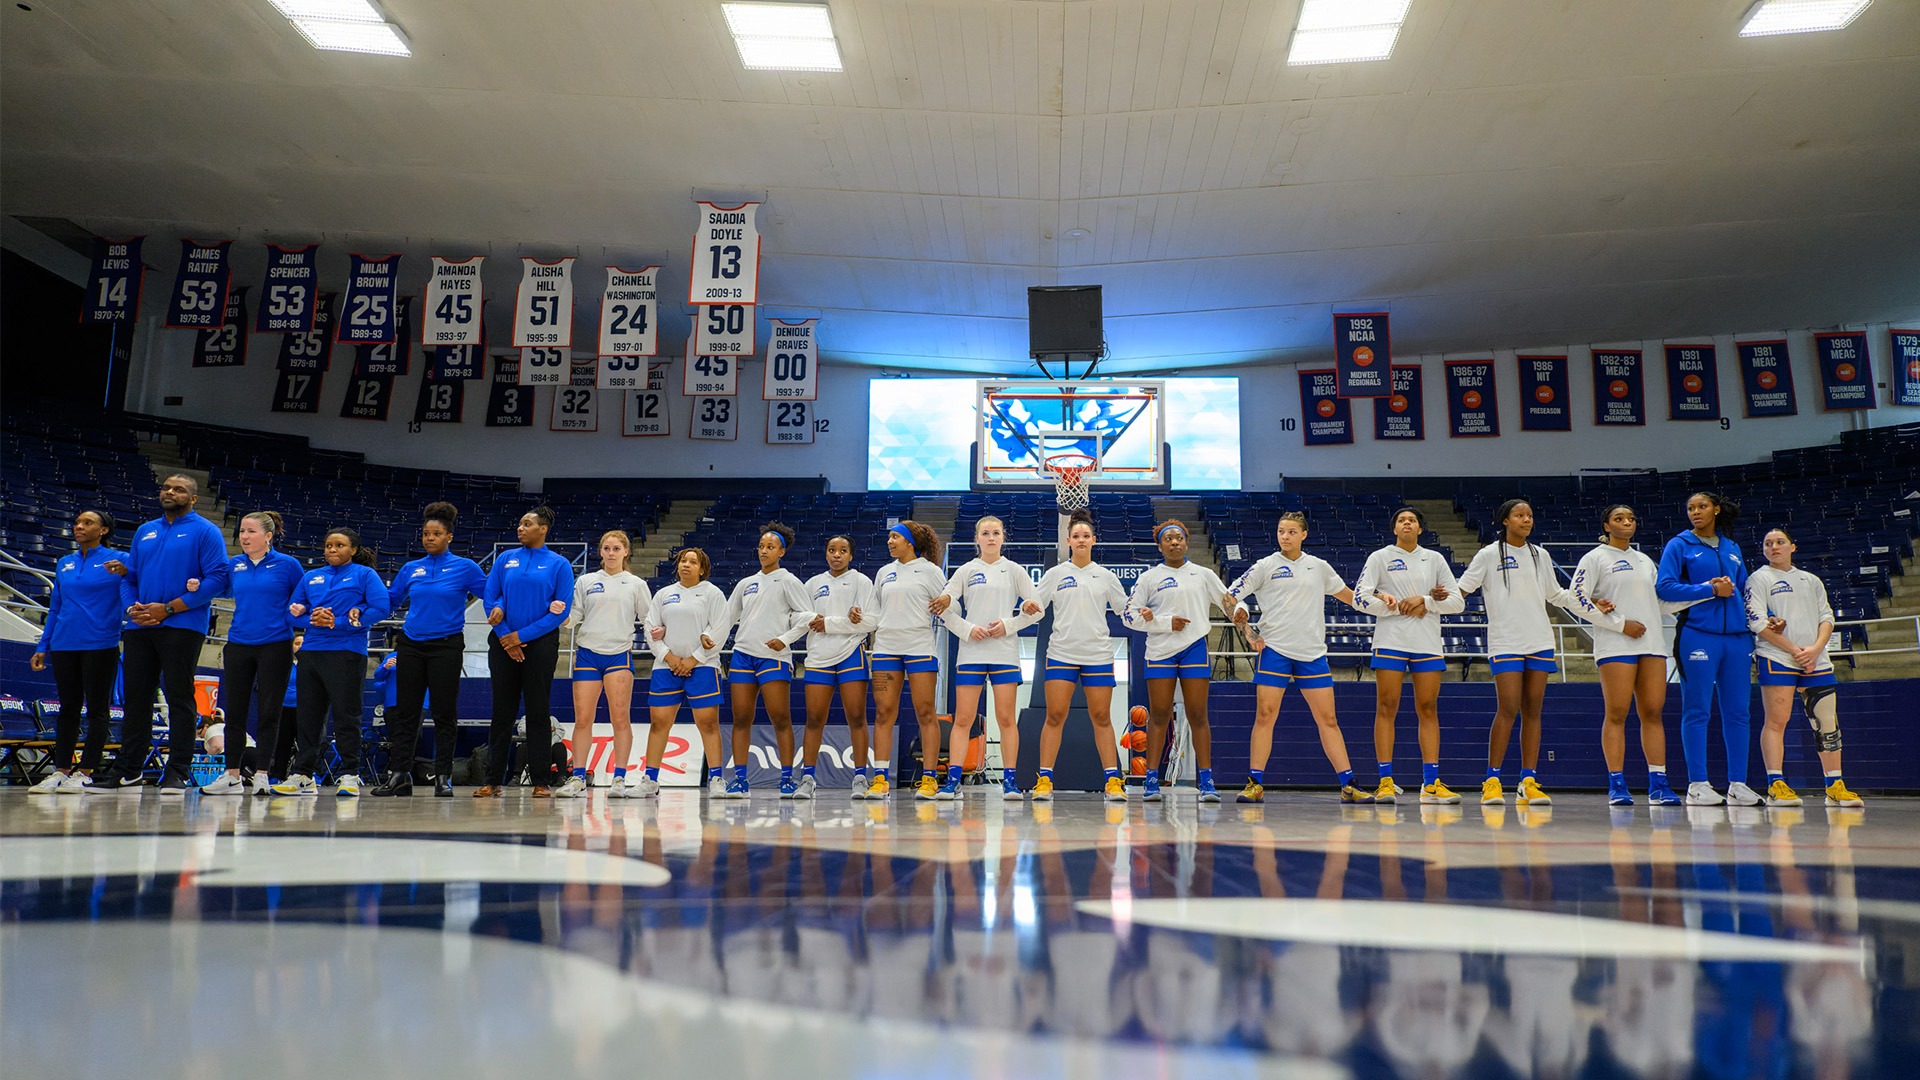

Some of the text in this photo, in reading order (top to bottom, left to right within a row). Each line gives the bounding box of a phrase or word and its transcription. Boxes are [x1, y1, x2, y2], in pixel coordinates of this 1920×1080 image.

[709, 213, 746, 224] SAADIA
[711, 229, 742, 240] DOYLE
[109, 245, 127, 255] BOB
[189, 249, 220, 259] JAMES
[279, 254, 304, 264] JOHN
[710, 246, 741, 279] 13
[102, 259, 129, 270] LEWIS
[187, 263, 218, 273] RATIFF
[360, 264, 388, 274] MILAN
[270, 268, 310, 278] SPENCER
[437, 266, 476, 275] AMANDA
[531, 267, 563, 277] ALISHA
[357, 277, 389, 287] BROWN
[441, 280, 471, 289] HAYES
[537, 281, 556, 291] HILL
[612, 276, 651, 286] CHANELL
[99, 277, 127, 307] 14
[180, 280, 217, 311] 53
[706, 289, 742, 298] 2009-13
[269, 286, 305, 316] 53
[351, 295, 387, 325] 25
[436, 295, 472, 323] 45
[530, 296, 559, 325] 51
[94, 311, 125, 319] 1970-74
[180, 314, 210, 323] 1979-82
[610, 305, 647, 334] 24
[709, 305, 744, 334] 50
[269, 320, 300, 328] 1984-88
[1350, 319, 1373, 330] 1992
[204, 324, 238, 351] 23
[351, 329, 382, 338] 1989-93
[776, 328, 810, 337] DENIQUE
[1349, 331, 1375, 341] NCAA
[289, 329, 323, 356] 35
[527, 334, 557, 342] 1995-99
[1897, 336, 1920, 345] 1979-
[613, 343, 642, 351] 1997-01
[710, 343, 741, 352] 1999-02
[777, 340, 808, 350] GRAVES
[1831, 339, 1852, 348] 1980
[446, 345, 472, 365] 31
[1681, 351, 1700, 360] 1981
[1753, 347, 1772, 357] 1981
[1831, 349, 1856, 359] MEAC
[1904, 347, 1920, 356] MEA
[1599, 356, 1635, 365] 1982-83
[1679, 361, 1703, 370] NCAA
[1752, 357, 1776, 367] MEAC
[695, 356, 728, 376] 45
[774, 354, 806, 380] 00
[1533, 362, 1553, 371] 1986
[1606, 366, 1630, 376] MEAC
[1392, 371, 1413, 380] 91-92
[1452, 367, 1487, 376] 1986-87
[1537, 372, 1550, 381] NIT
[1313, 375, 1333, 385] 1992
[1348, 378, 1381, 386] REGIONALS
[1459, 377, 1483, 387] MEAC
[287, 375, 311, 399] 17
[696, 384, 724, 392] 1990-94
[1394, 381, 1409, 390] EAC
[357, 380, 381, 404] 12
[1313, 386, 1336, 396] MEAC
[430, 385, 452, 409] 13
[503, 389, 518, 413] 3
[562, 390, 591, 413] 32
[1751, 393, 1787, 401] TOURNAMENT
[636, 394, 659, 418] 12
[1679, 402, 1709, 410] REGIONALS
[1754, 399, 1787, 407] CHAMPIONS
[701, 399, 730, 423] 33
[777, 403, 806, 427] 23
[408, 421, 421, 433] 13
[814, 420, 829, 432] 12
[1280, 418, 1295, 431] 10
[1720, 417, 1730, 430] 9
[1, 701, 24, 711] BISON
[41, 702, 61, 712] BISO
